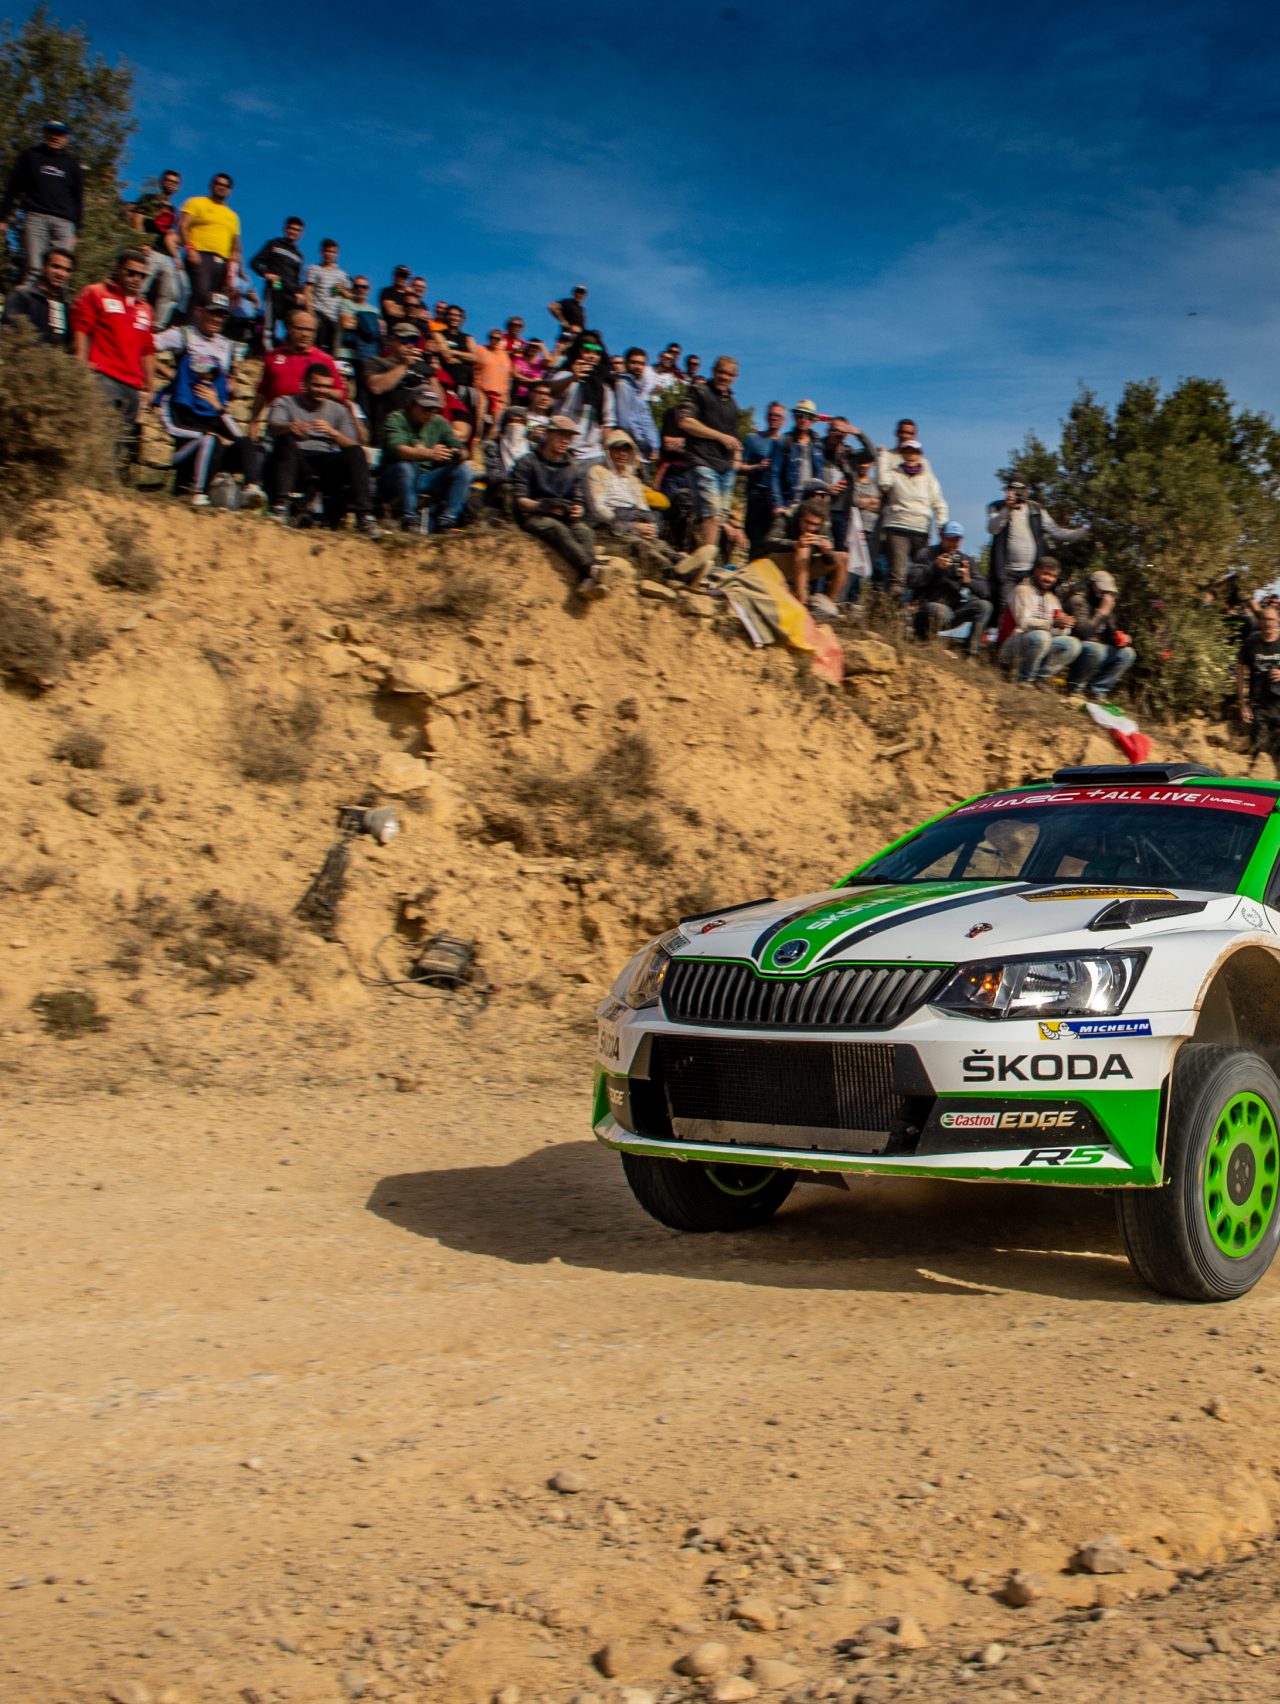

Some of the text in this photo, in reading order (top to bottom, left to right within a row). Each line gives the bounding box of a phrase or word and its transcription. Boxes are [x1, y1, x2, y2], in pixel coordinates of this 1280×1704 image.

[1148, 791, 1201, 803] LIVE
[1079, 1022, 1149, 1033] MICHELIN
[962, 1049, 1134, 1083] ŠKODA
[955, 1110, 1079, 1129] Castrol EDGE
[1019, 1147, 1111, 1167] R5
